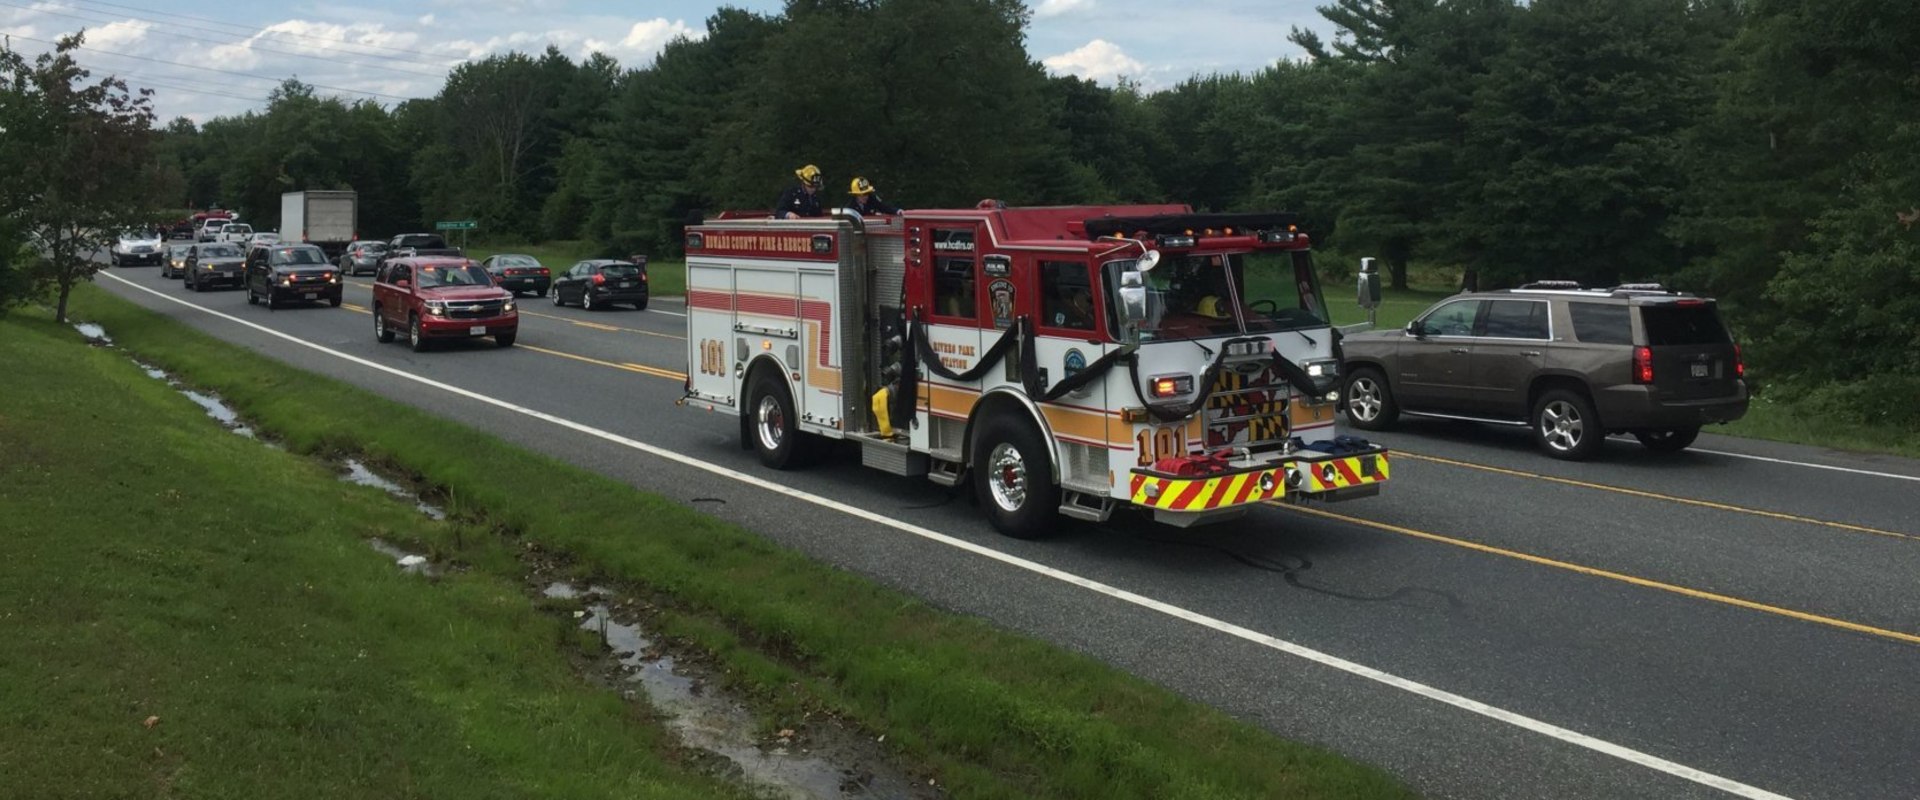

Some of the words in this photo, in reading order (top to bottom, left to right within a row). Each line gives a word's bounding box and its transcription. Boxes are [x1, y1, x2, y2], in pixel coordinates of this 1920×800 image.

[705, 235, 730, 249] HOWARD
[731, 236, 757, 250] COUNTY
[759, 236, 776, 251] FIRE
[777, 237, 783, 251] &
[783, 237, 811, 252] RESCUE
[700, 338, 725, 377] 101
[958, 344, 975, 356] PARK
[941, 356, 968, 369] STATION
[1137, 424, 1185, 467] 101
